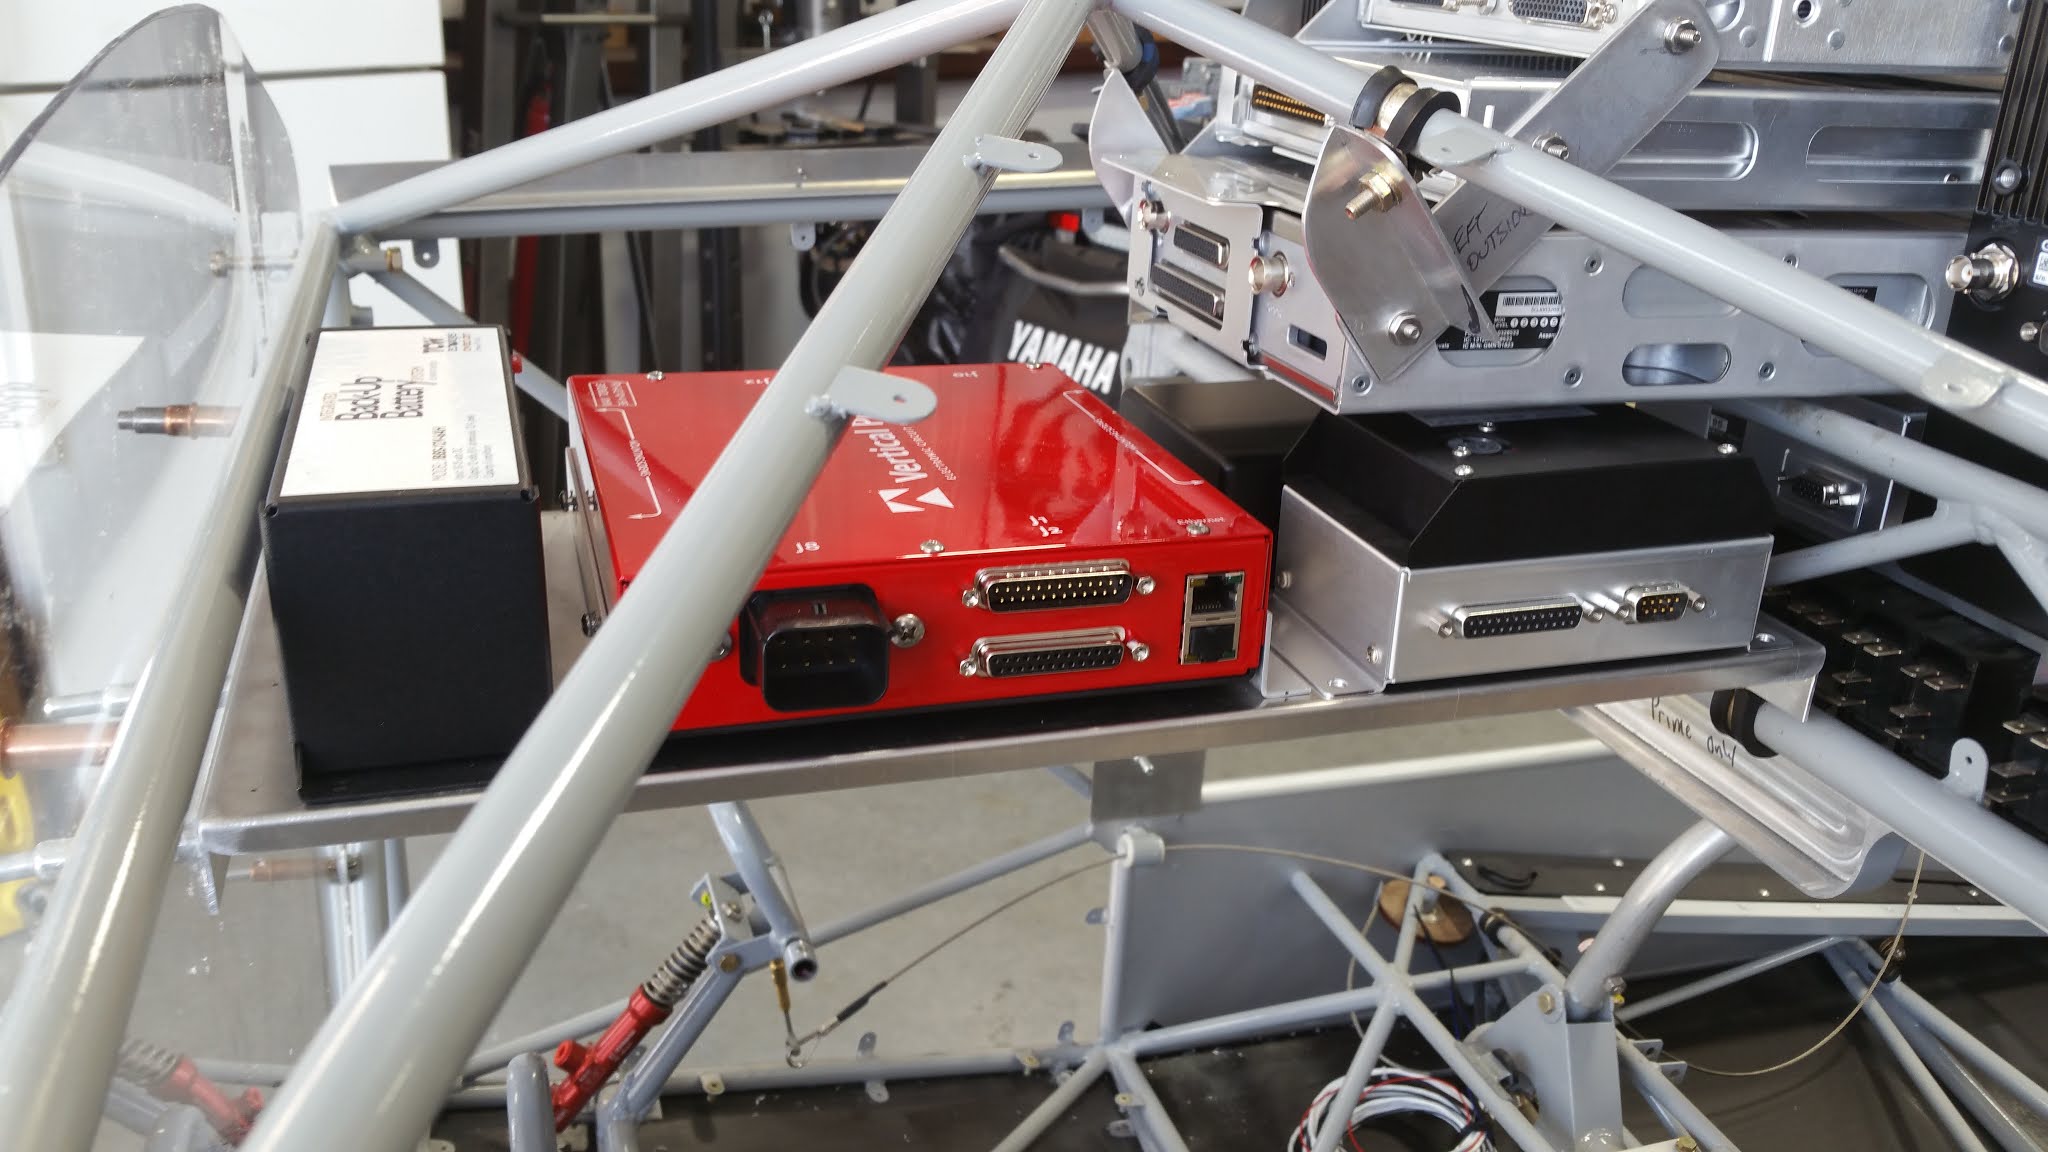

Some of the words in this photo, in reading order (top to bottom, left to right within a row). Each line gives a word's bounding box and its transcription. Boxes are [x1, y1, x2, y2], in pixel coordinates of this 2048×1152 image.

[1453, 203, 1488, 254] EFT
[1007, 319, 1120, 395] YAMAHA
[334, 376, 395, 421] Back-Up
[380, 379, 437, 419] Battery
[854, 428, 928, 484] Vertical
[795, 541, 821, 554] J8
